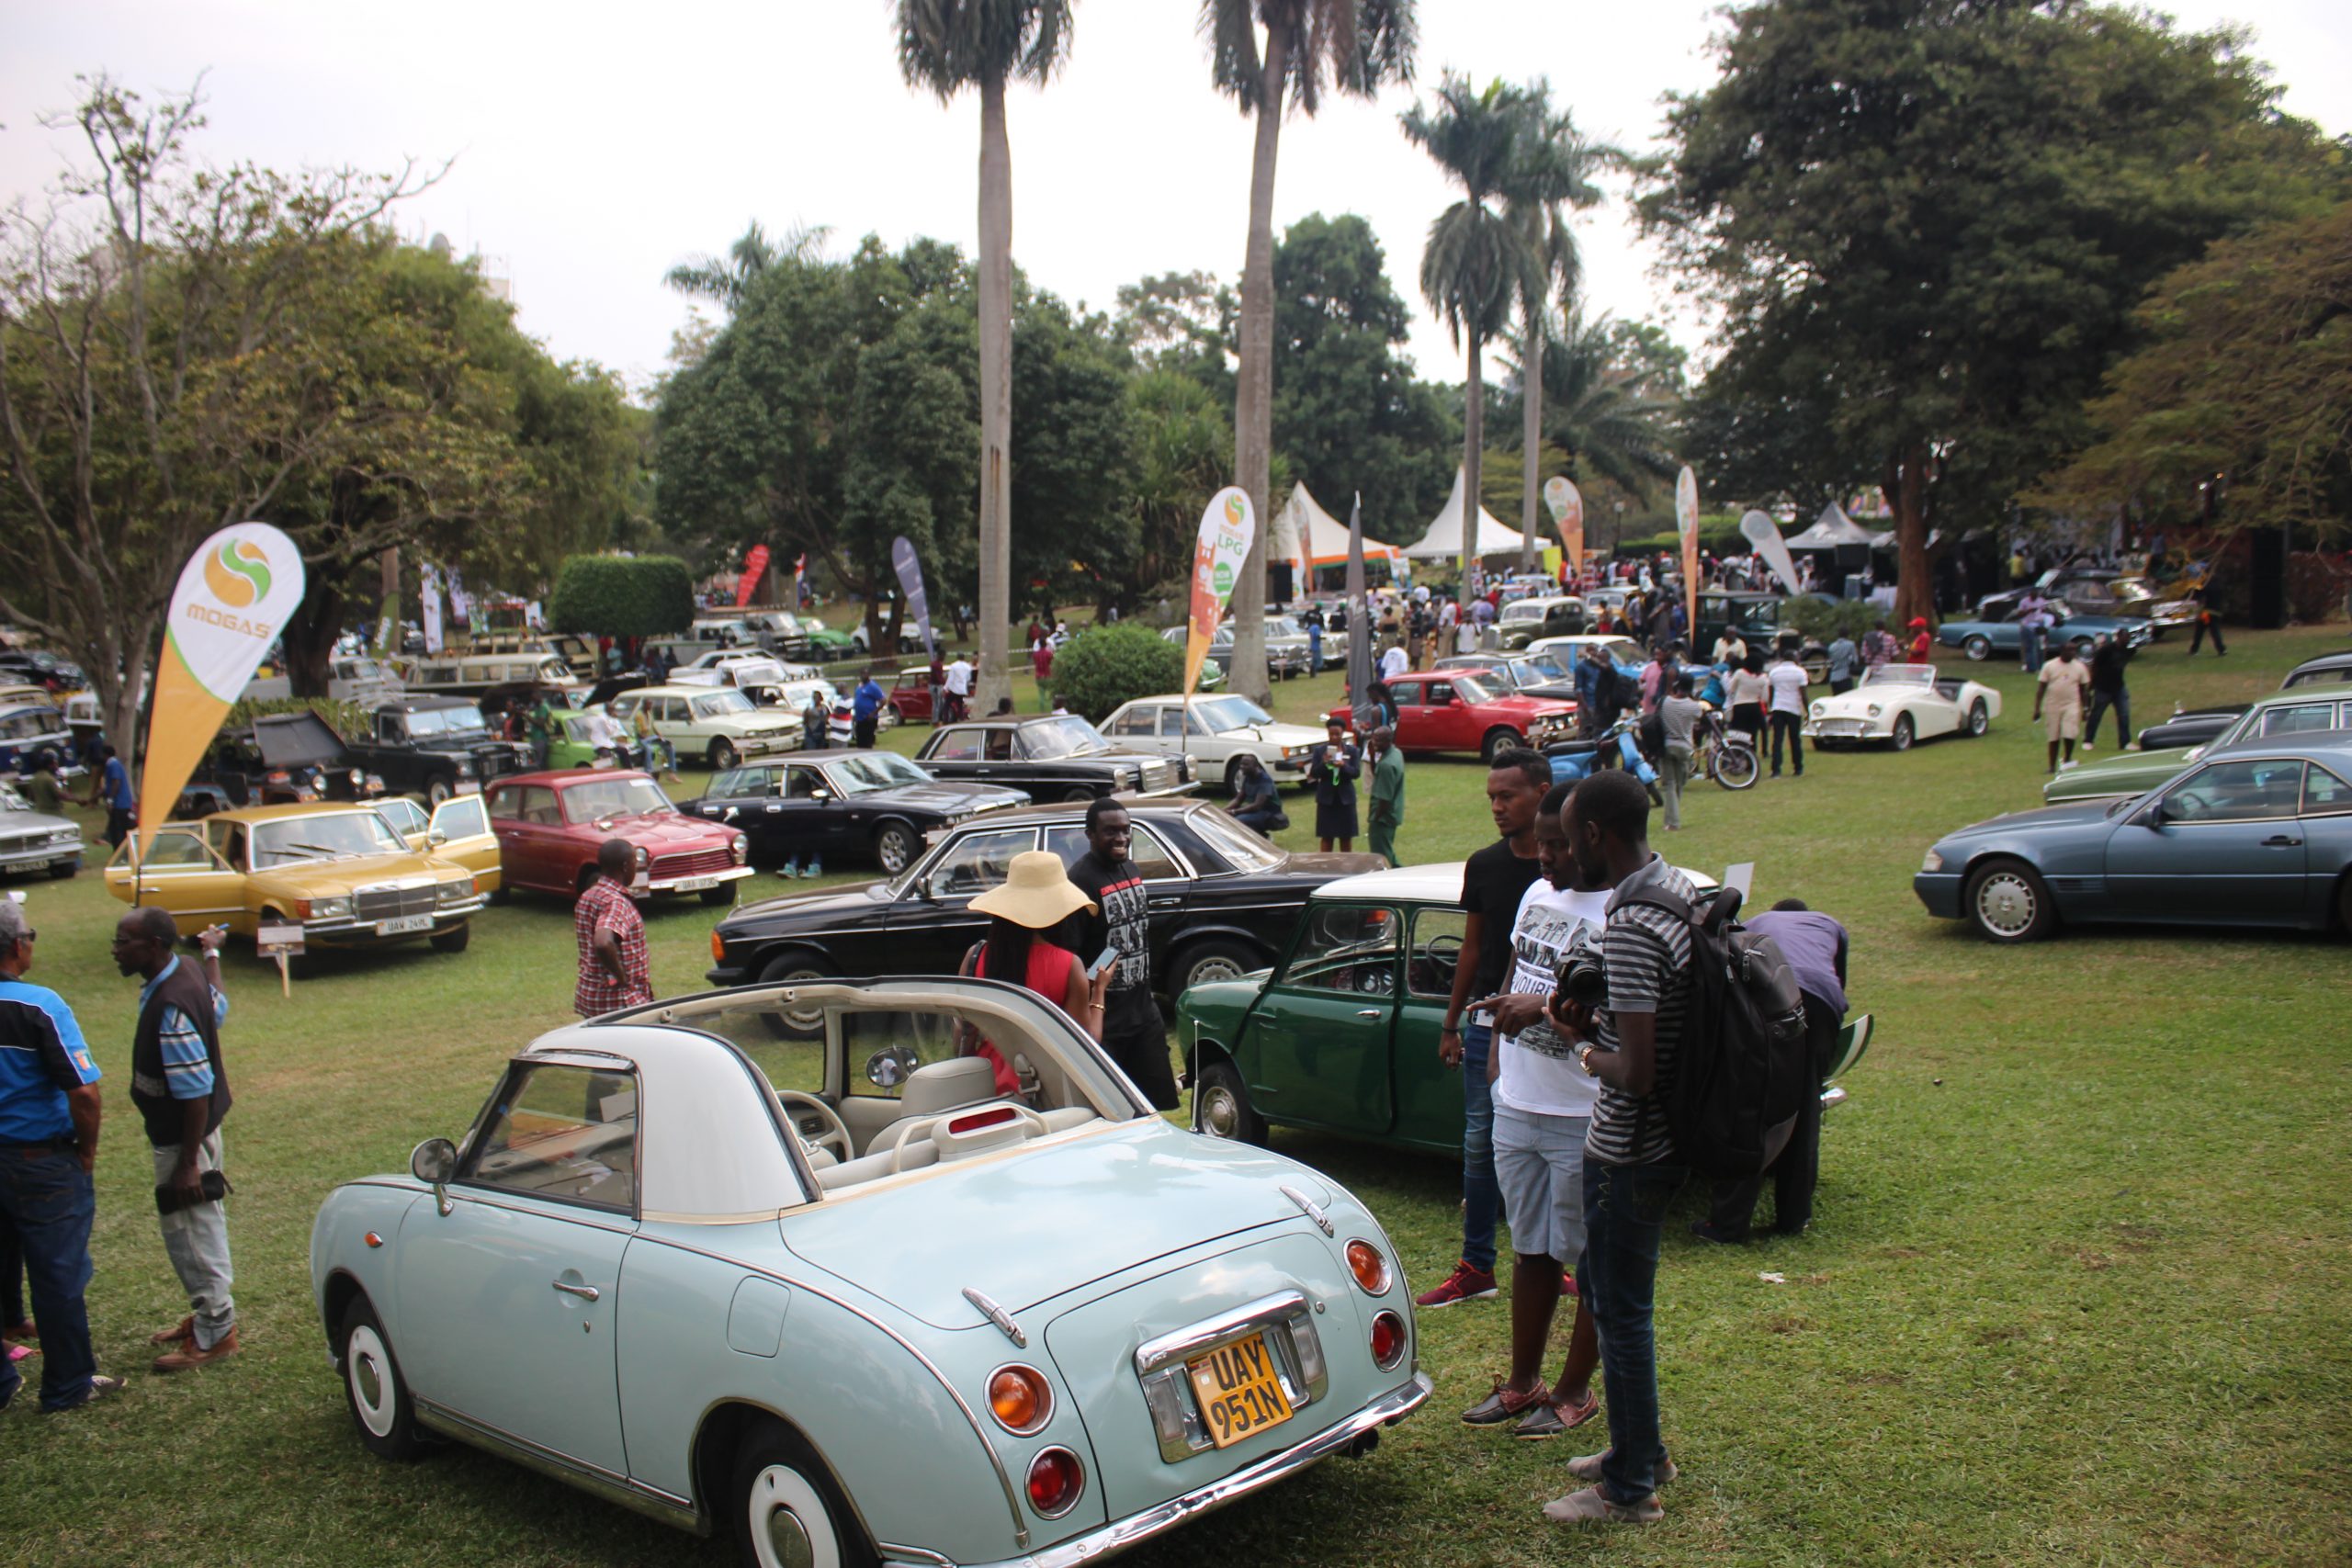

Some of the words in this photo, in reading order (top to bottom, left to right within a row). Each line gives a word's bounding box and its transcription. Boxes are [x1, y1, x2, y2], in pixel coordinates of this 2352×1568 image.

[1217, 534, 1243, 557] LPG
[187, 603, 270, 640] MOGAS
[375, 616, 391, 649] Jeep
[1210, 1339, 1263, 1391] UAY
[1211, 1381, 1283, 1439] 951N
